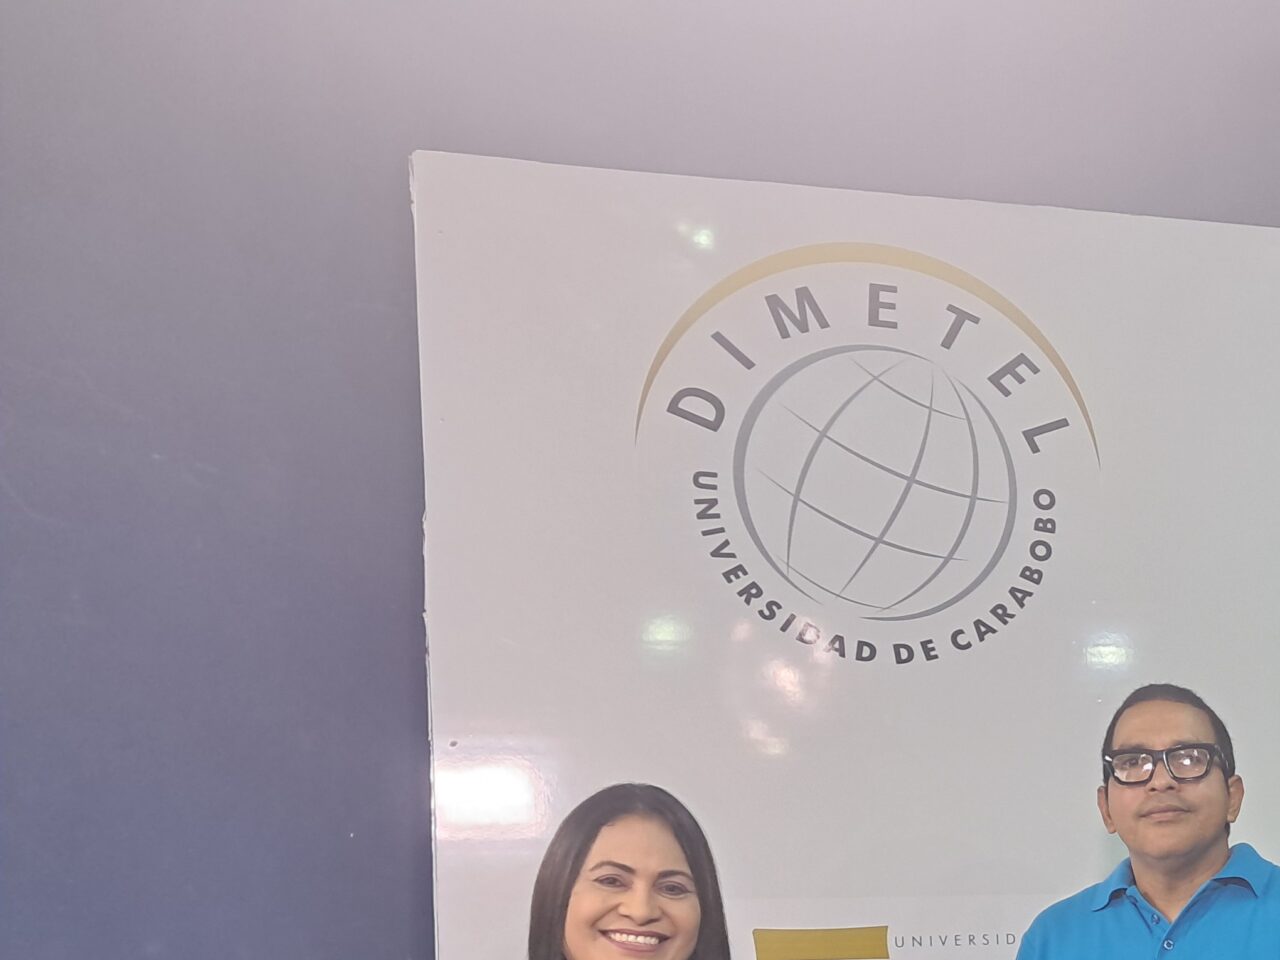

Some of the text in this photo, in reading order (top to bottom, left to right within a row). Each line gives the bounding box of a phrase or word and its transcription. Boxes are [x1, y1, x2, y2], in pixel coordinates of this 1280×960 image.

[666, 283, 1070, 454] DIMETEL
[692, 470, 1057, 665] UNIVERSIDAD DE CARABOBO
[894, 933, 1017, 948] UNIVERSID
